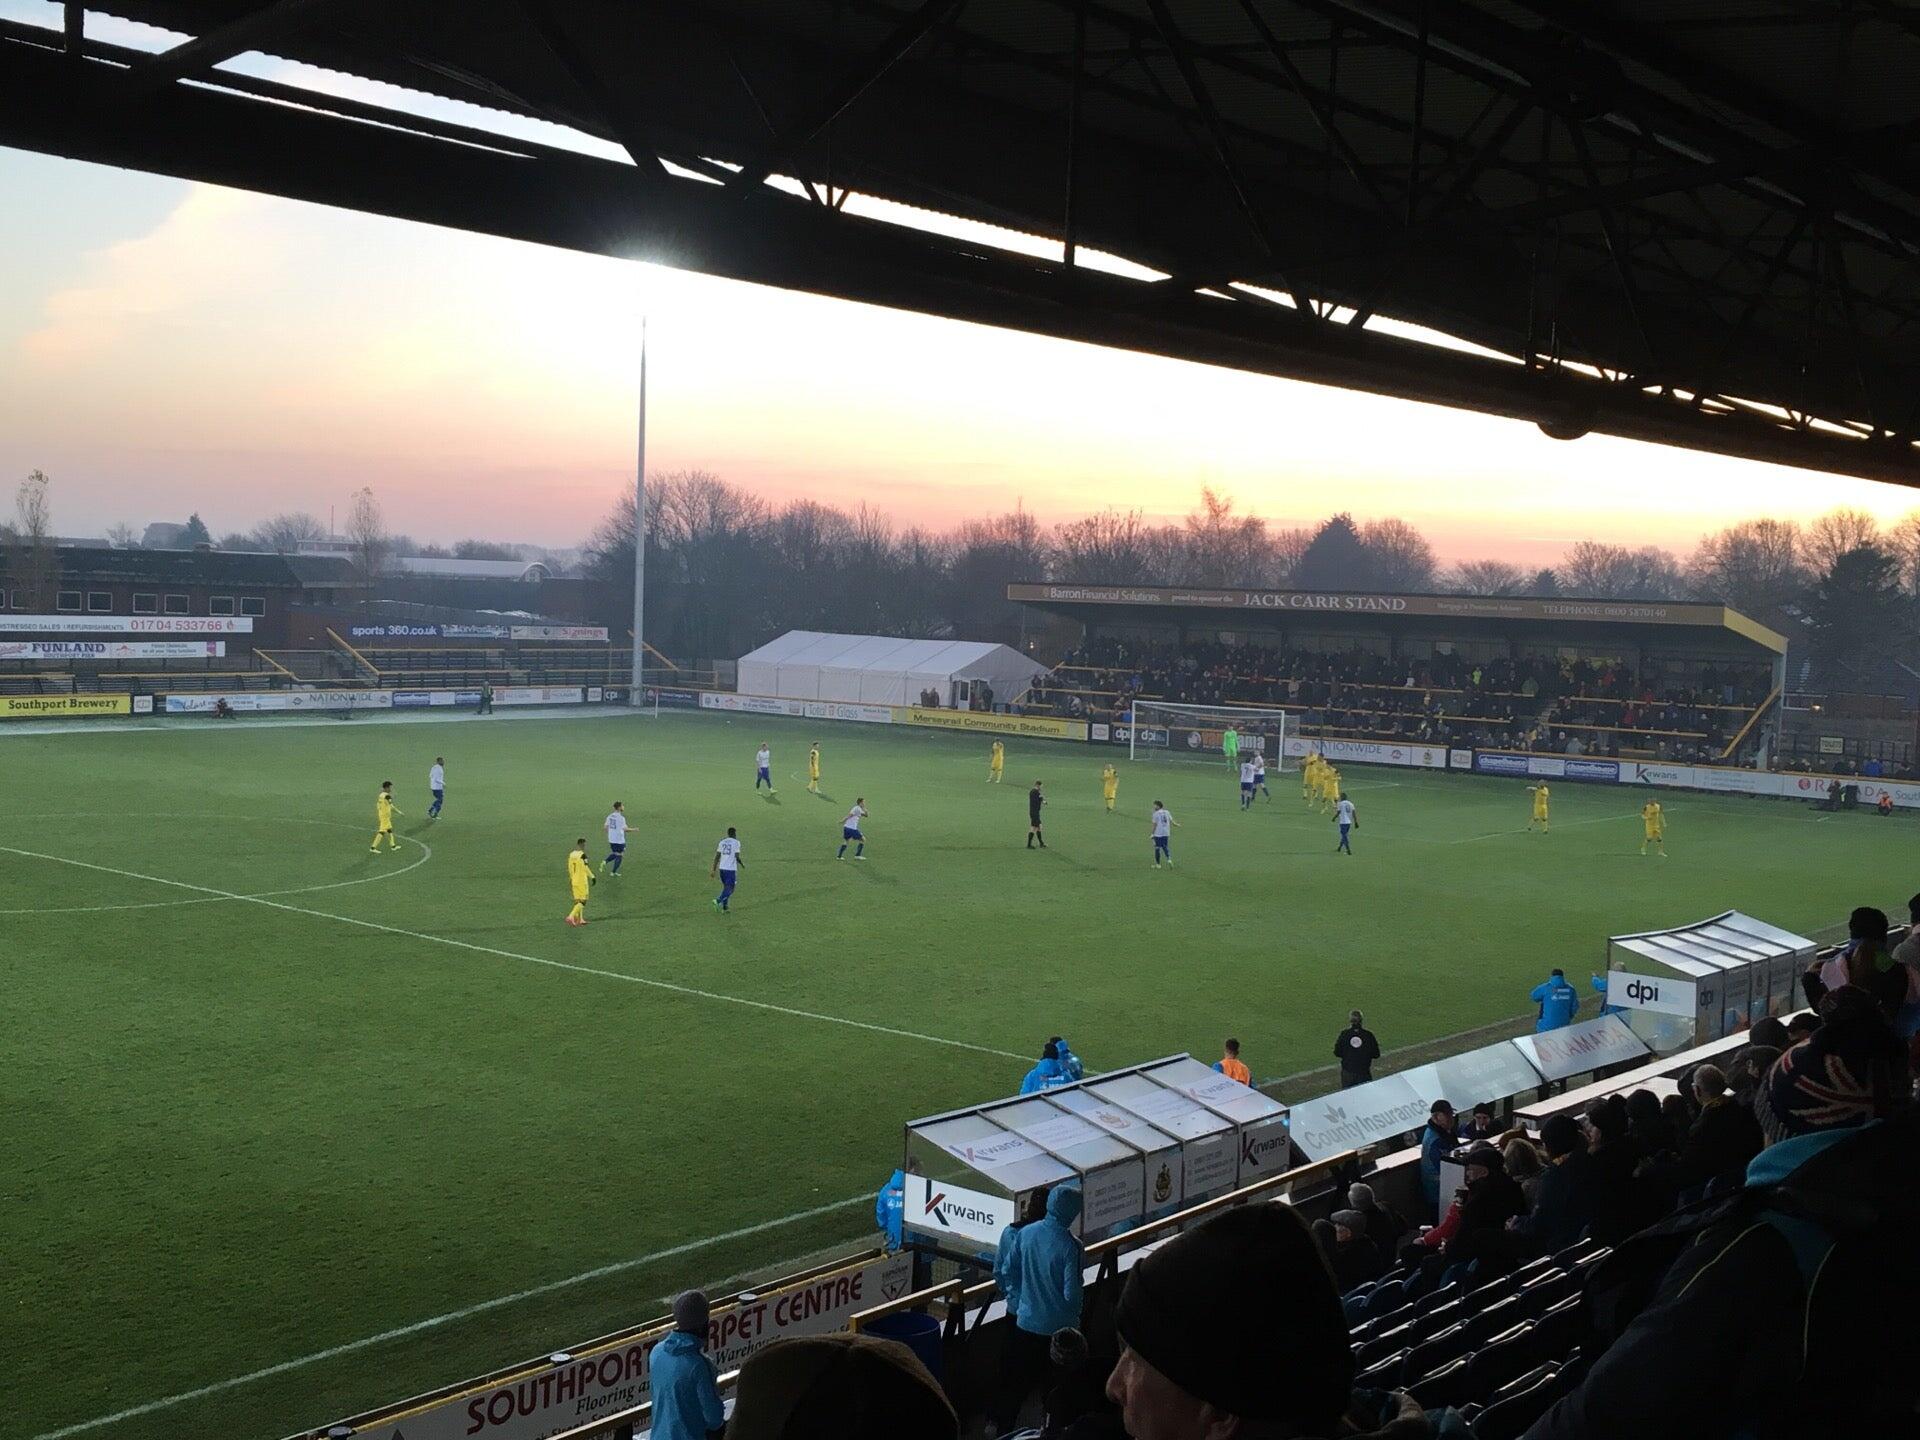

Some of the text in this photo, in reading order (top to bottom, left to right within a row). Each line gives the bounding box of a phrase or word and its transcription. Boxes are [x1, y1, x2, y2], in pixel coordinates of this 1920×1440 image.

[1050, 587, 1161, 602] Barron Financial Solutions
[1243, 593, 1406, 611] JACK CARR STAND
[130, 620, 222, 631] 01704 533766
[352, 626, 385, 637] sports
[388, 625, 437, 636] 360.co.uk
[32, 643, 106, 653] FUNLAND
[8, 698, 118, 711] Southport Brewery
[310, 692, 373, 702] NATIONWIDE
[809, 704, 827, 716] Total
[838, 706, 859, 720] Glass
[913, 714, 1060, 734] Merseyrail Community Stadium
[1311, 740, 1383, 755] NATIONWIDE
[1626, 979, 1659, 1005] dpi
[1242, 1131, 1287, 1167] Kirwans
[925, 1179, 994, 1227] Kirwans
[702, 1303, 767, 1354] RPET
[774, 1271, 864, 1328] CENTRE
[575, 1384, 635, 1416] Flooring
